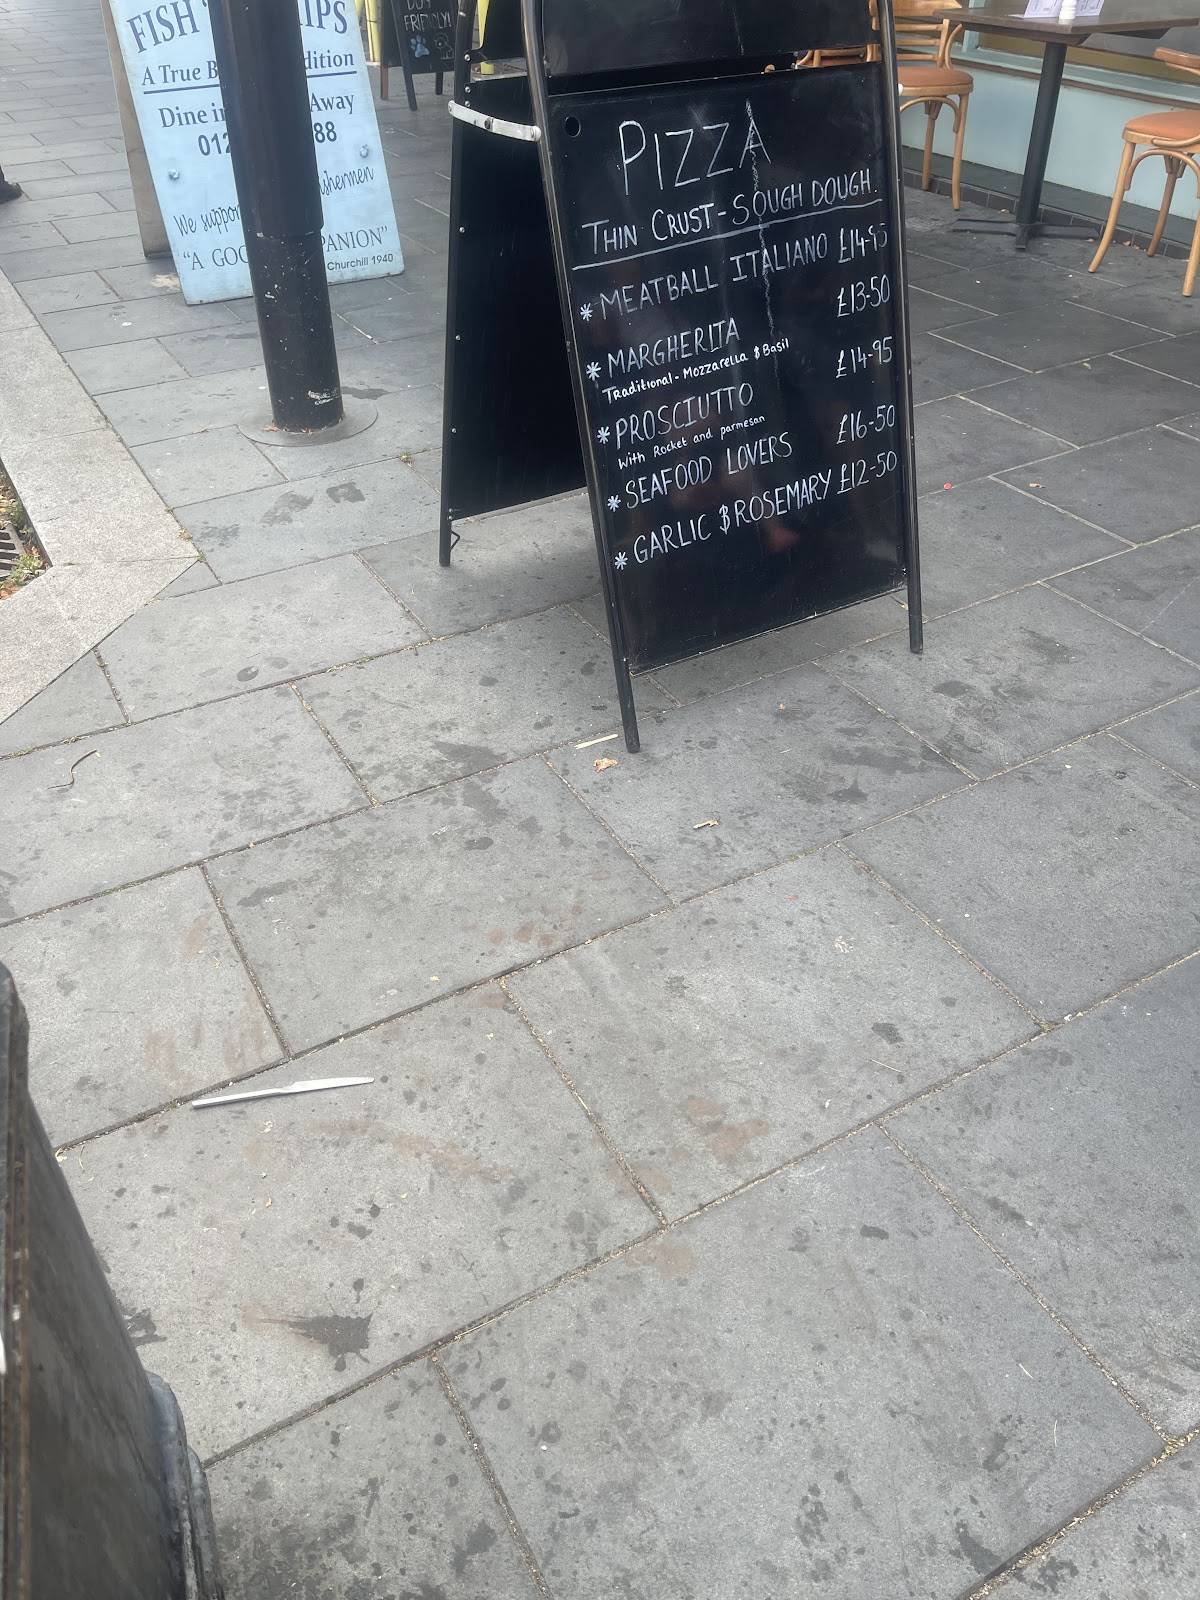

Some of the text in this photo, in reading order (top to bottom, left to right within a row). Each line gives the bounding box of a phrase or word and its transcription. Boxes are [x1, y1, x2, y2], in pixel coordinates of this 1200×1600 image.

[127, 0, 200, 53] FISH
[142, 49, 355, 86] A True B dition
[158, 106, 208, 128] Dine
[198, 121, 337, 156] 012 88
[618, 117, 772, 196] PIZZA
[173, 166, 374, 237] We suppor shermen
[327, 253, 394, 271] Churchill 1940
[581, 219, 638, 255] THIN
[600, 265, 719, 321] MEATBALL
[730, 233, 828, 282] ITALIANO
[607, 317, 740, 378] MARGHERITA
[762, 337, 790, 357] Basil
[615, 382, 754, 449] PROSCIUTTO
[618, 415, 766, 469] With Rocket and parmesan
[625, 455, 713, 509] SEAFOOD
[726, 432, 793, 476] LOVERS
[633, 513, 712, 565] GARLIC
[734, 468, 832, 528] ROSEMARY
